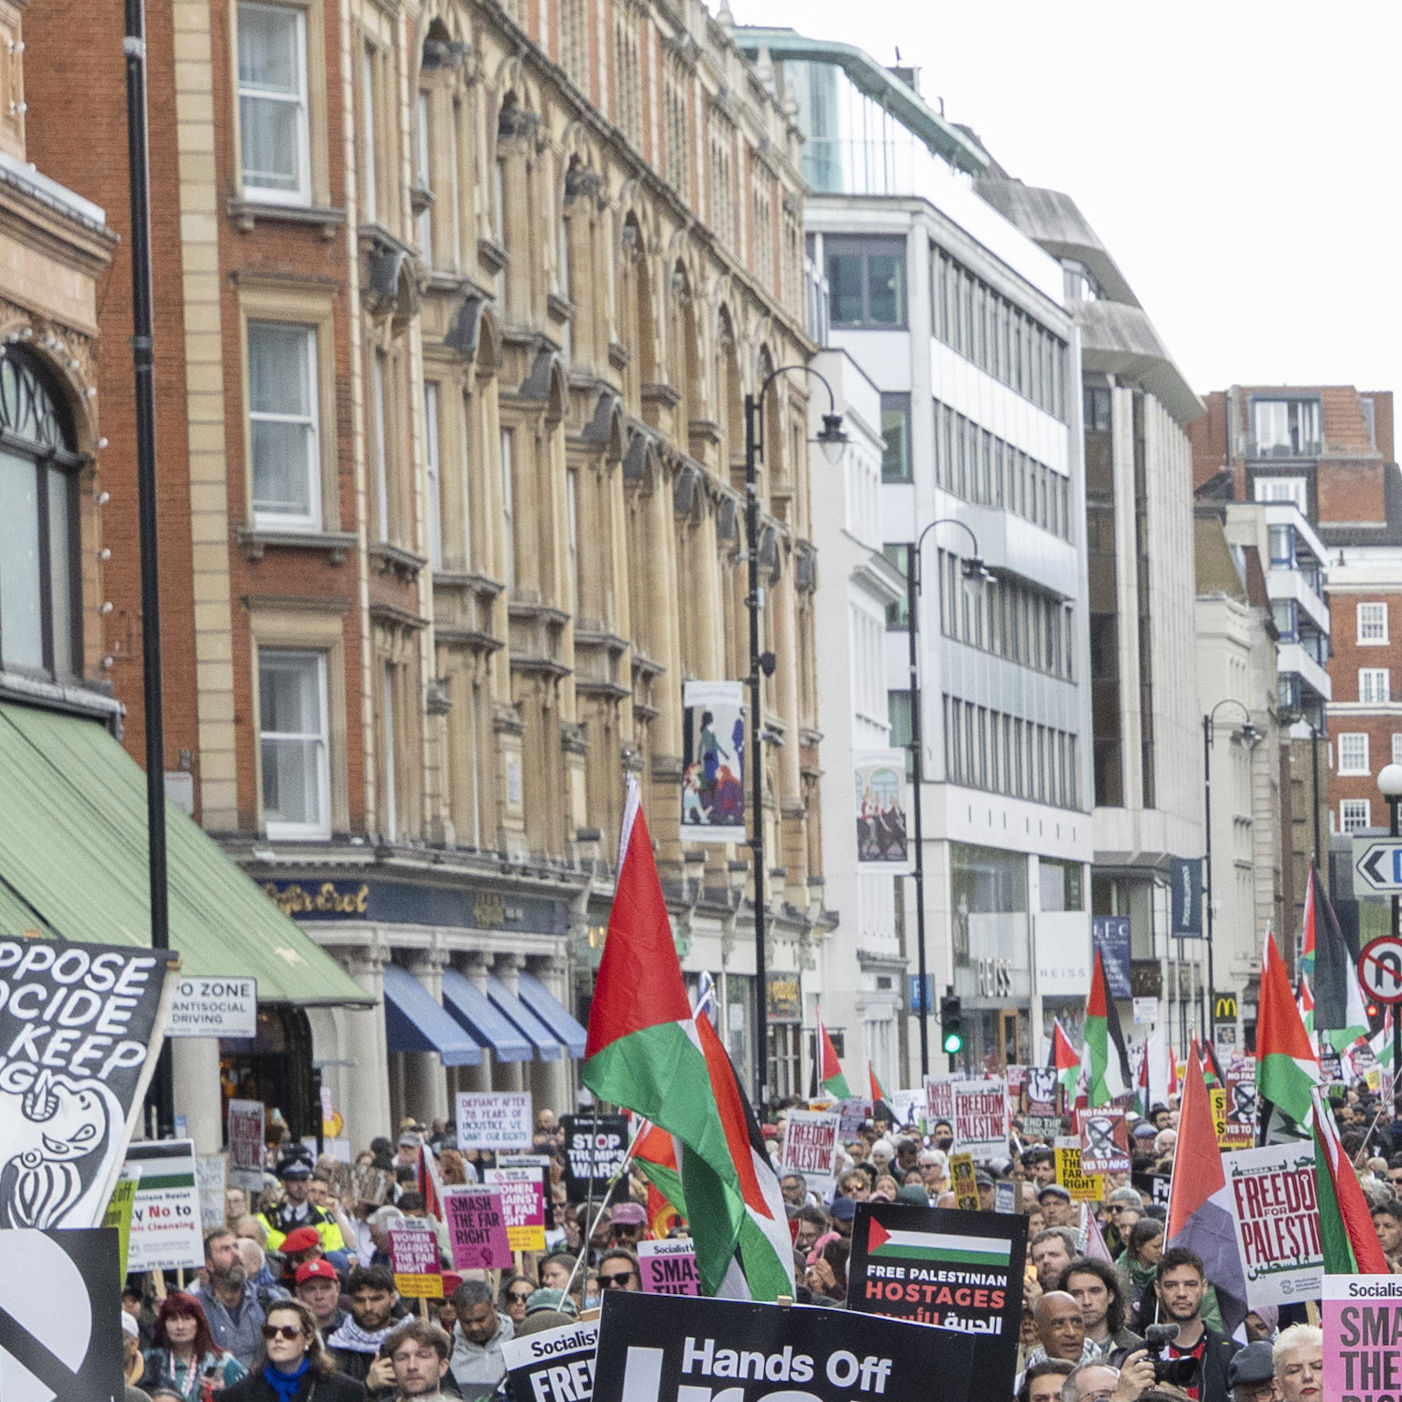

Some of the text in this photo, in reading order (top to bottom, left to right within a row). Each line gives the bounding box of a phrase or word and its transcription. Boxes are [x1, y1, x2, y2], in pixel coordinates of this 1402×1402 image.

[201, 982, 249, 997] ZONE
[172, 1002, 245, 1012] ANTISOCIAL
[173, 1014, 223, 1024] DRIVING
[8, 1023, 147, 1079] KEEP
[956, 1095, 1004, 1115] FREEDOM
[789, 1123, 835, 1144] FREEDOM
[957, 1116, 1004, 1138] PALESTINE
[786, 1148, 832, 1170] PALESTINE
[1109, 1159, 1129, 1169] NHS
[1063, 1180, 1095, 1189] RIGHT
[149, 1205, 191, 1218] No to
[451, 1197, 491, 1211] SMASH
[453, 1212, 500, 1227] THE FAR
[1264, 1207, 1287, 1217] FOR
[456, 1229, 491, 1244] RIGHT
[867, 1265, 1008, 1287] FREE PALESTINIAN
[866, 1280, 1006, 1309] HOSTAGES
[682, 1337, 892, 1394] Hands Off
[1340, 1351, 1400, 1390] THE
